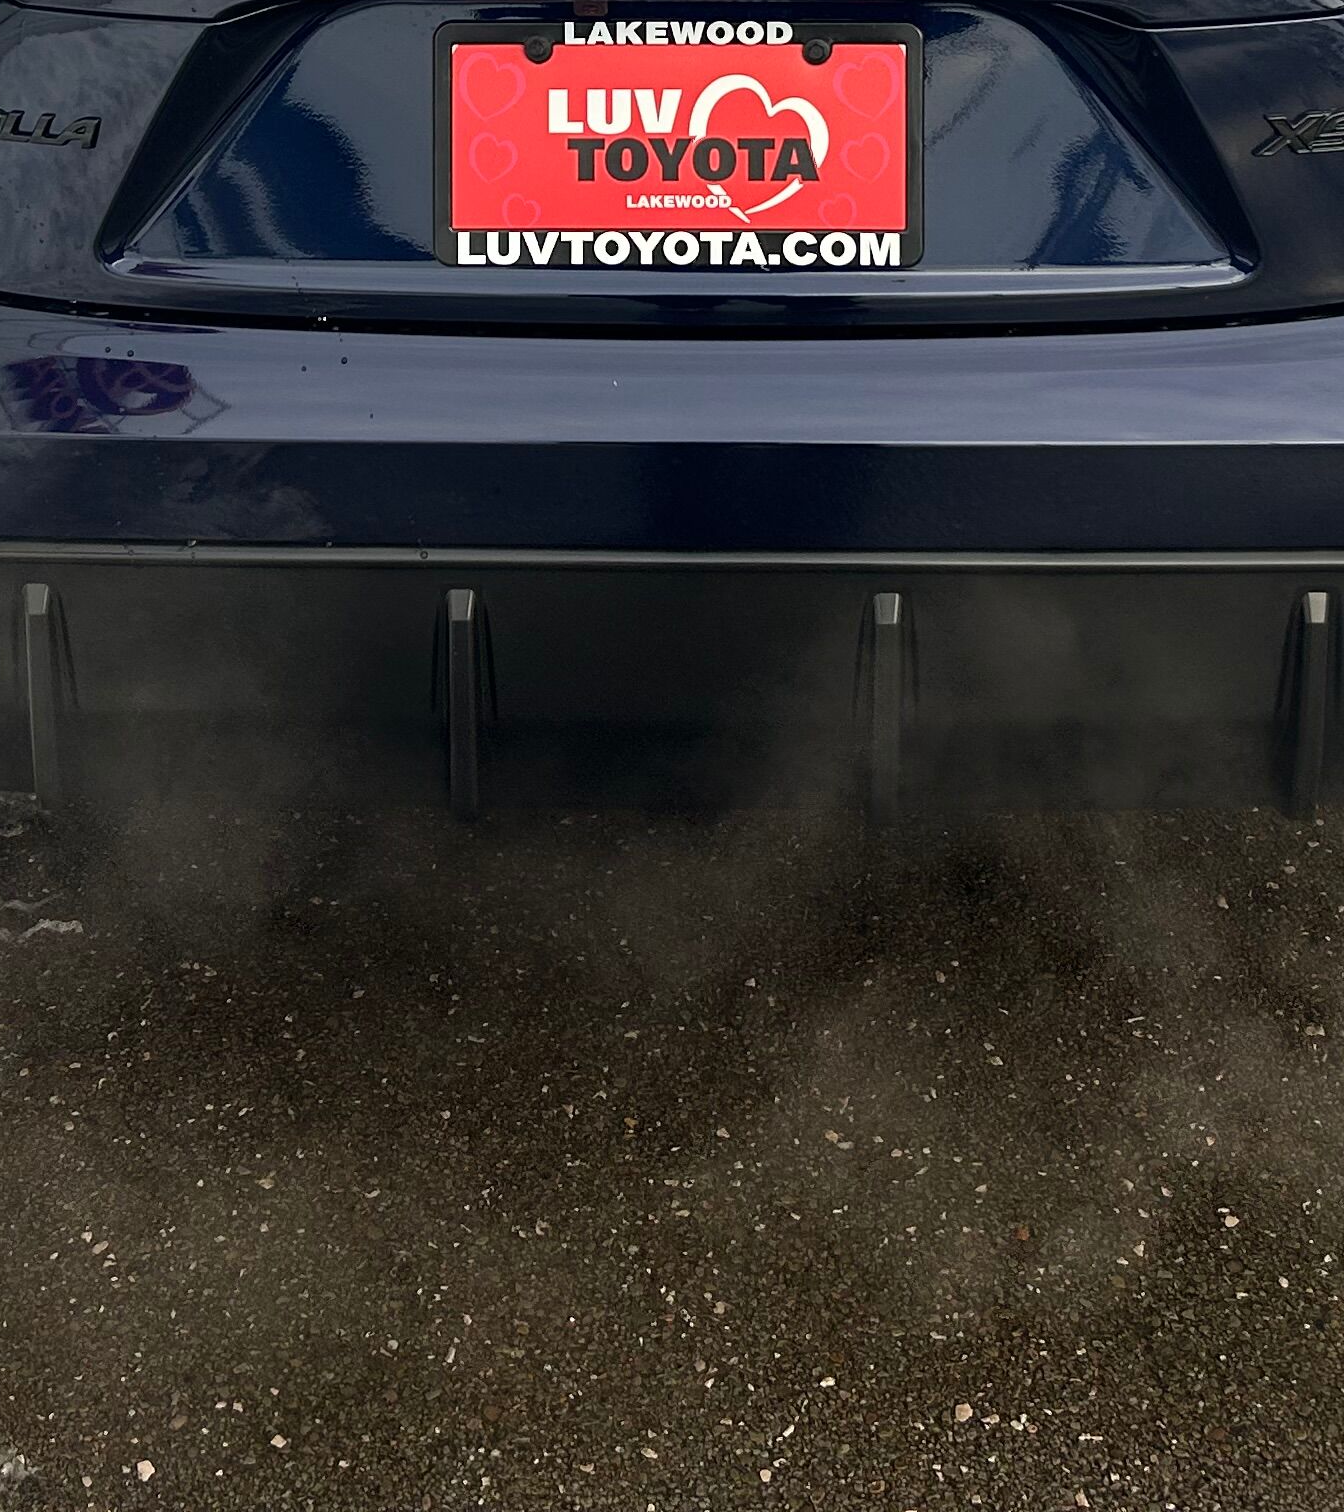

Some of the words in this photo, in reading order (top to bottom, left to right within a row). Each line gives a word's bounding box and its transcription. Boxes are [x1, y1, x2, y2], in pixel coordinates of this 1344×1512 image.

[564, 21, 794, 46] LAKEWOOD
[548, 88, 682, 136] LUV
[566, 138, 820, 183] TOYOTA
[626, 194, 733, 209] LAKEWOOD
[456, 231, 902, 267] LUVTOYOTA.COM
